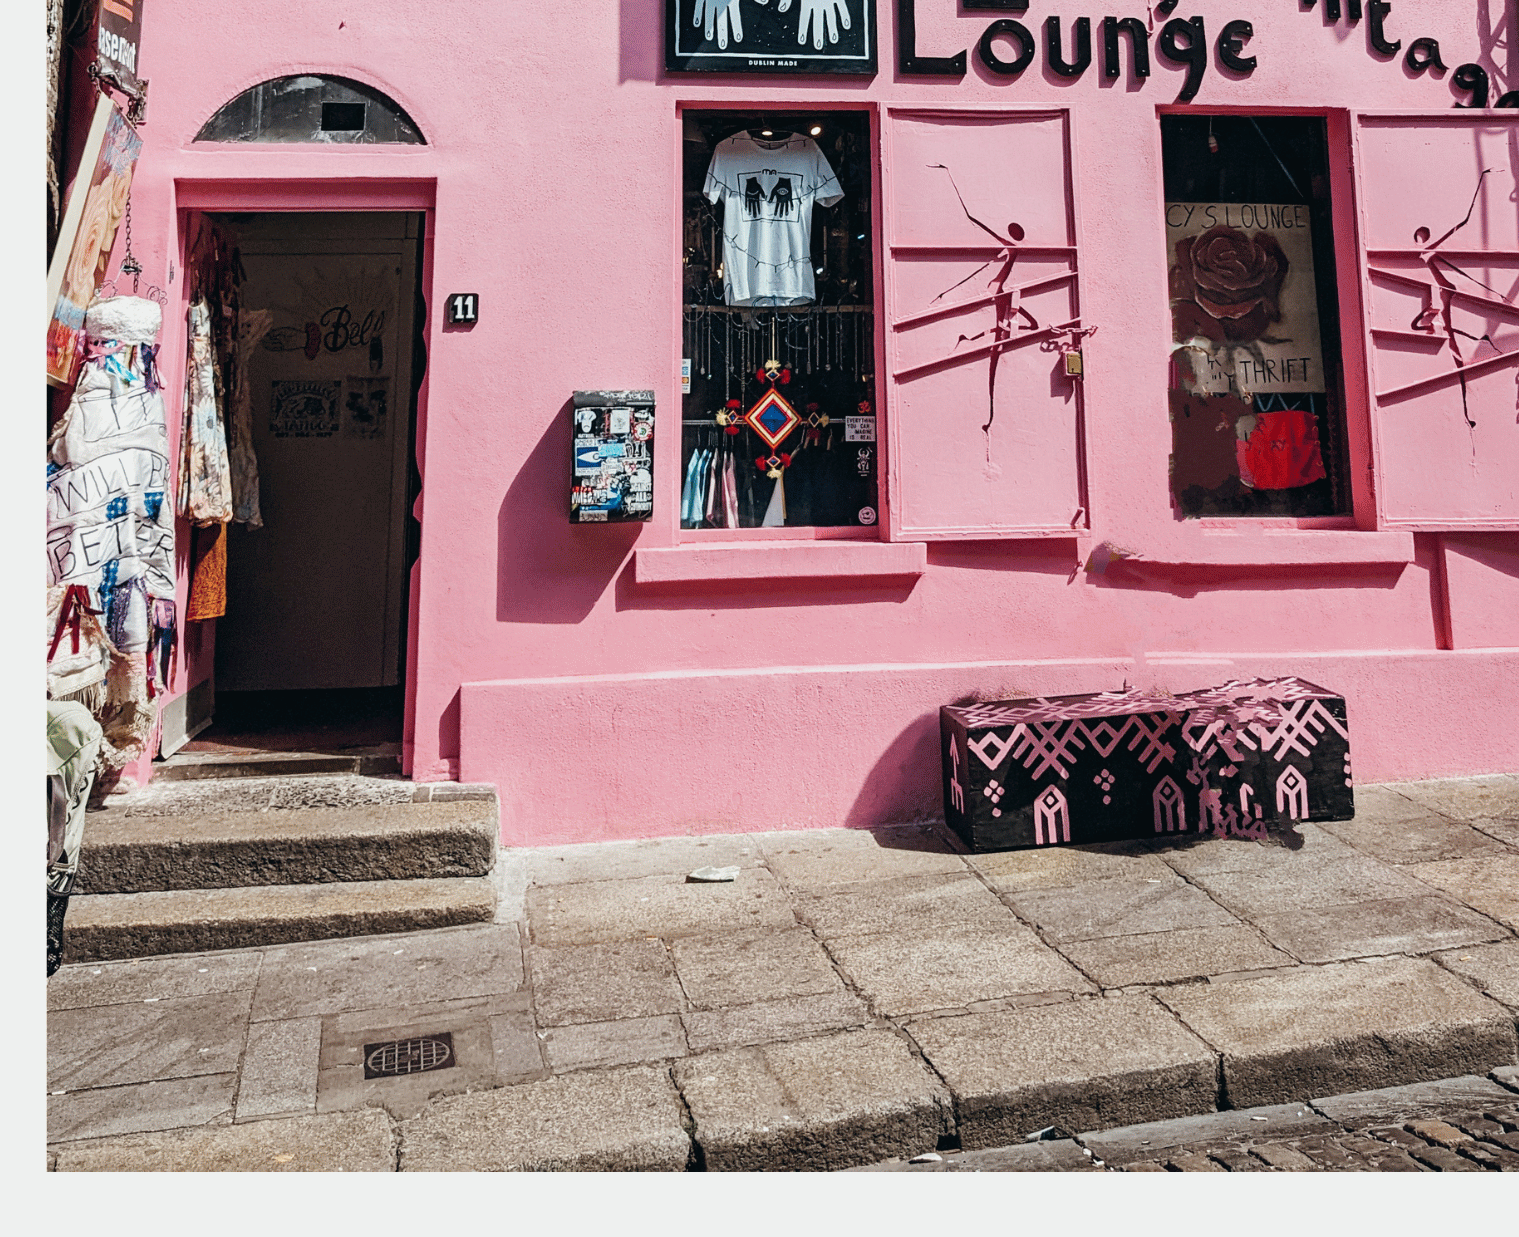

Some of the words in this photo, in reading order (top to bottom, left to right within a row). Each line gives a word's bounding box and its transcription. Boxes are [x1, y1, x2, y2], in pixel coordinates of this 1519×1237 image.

[1226, 204, 1306, 229] LOUNGE
[453, 295, 475, 319] 11
[1239, 357, 1311, 384] THRIFT
[55, 457, 140, 512] WILL
